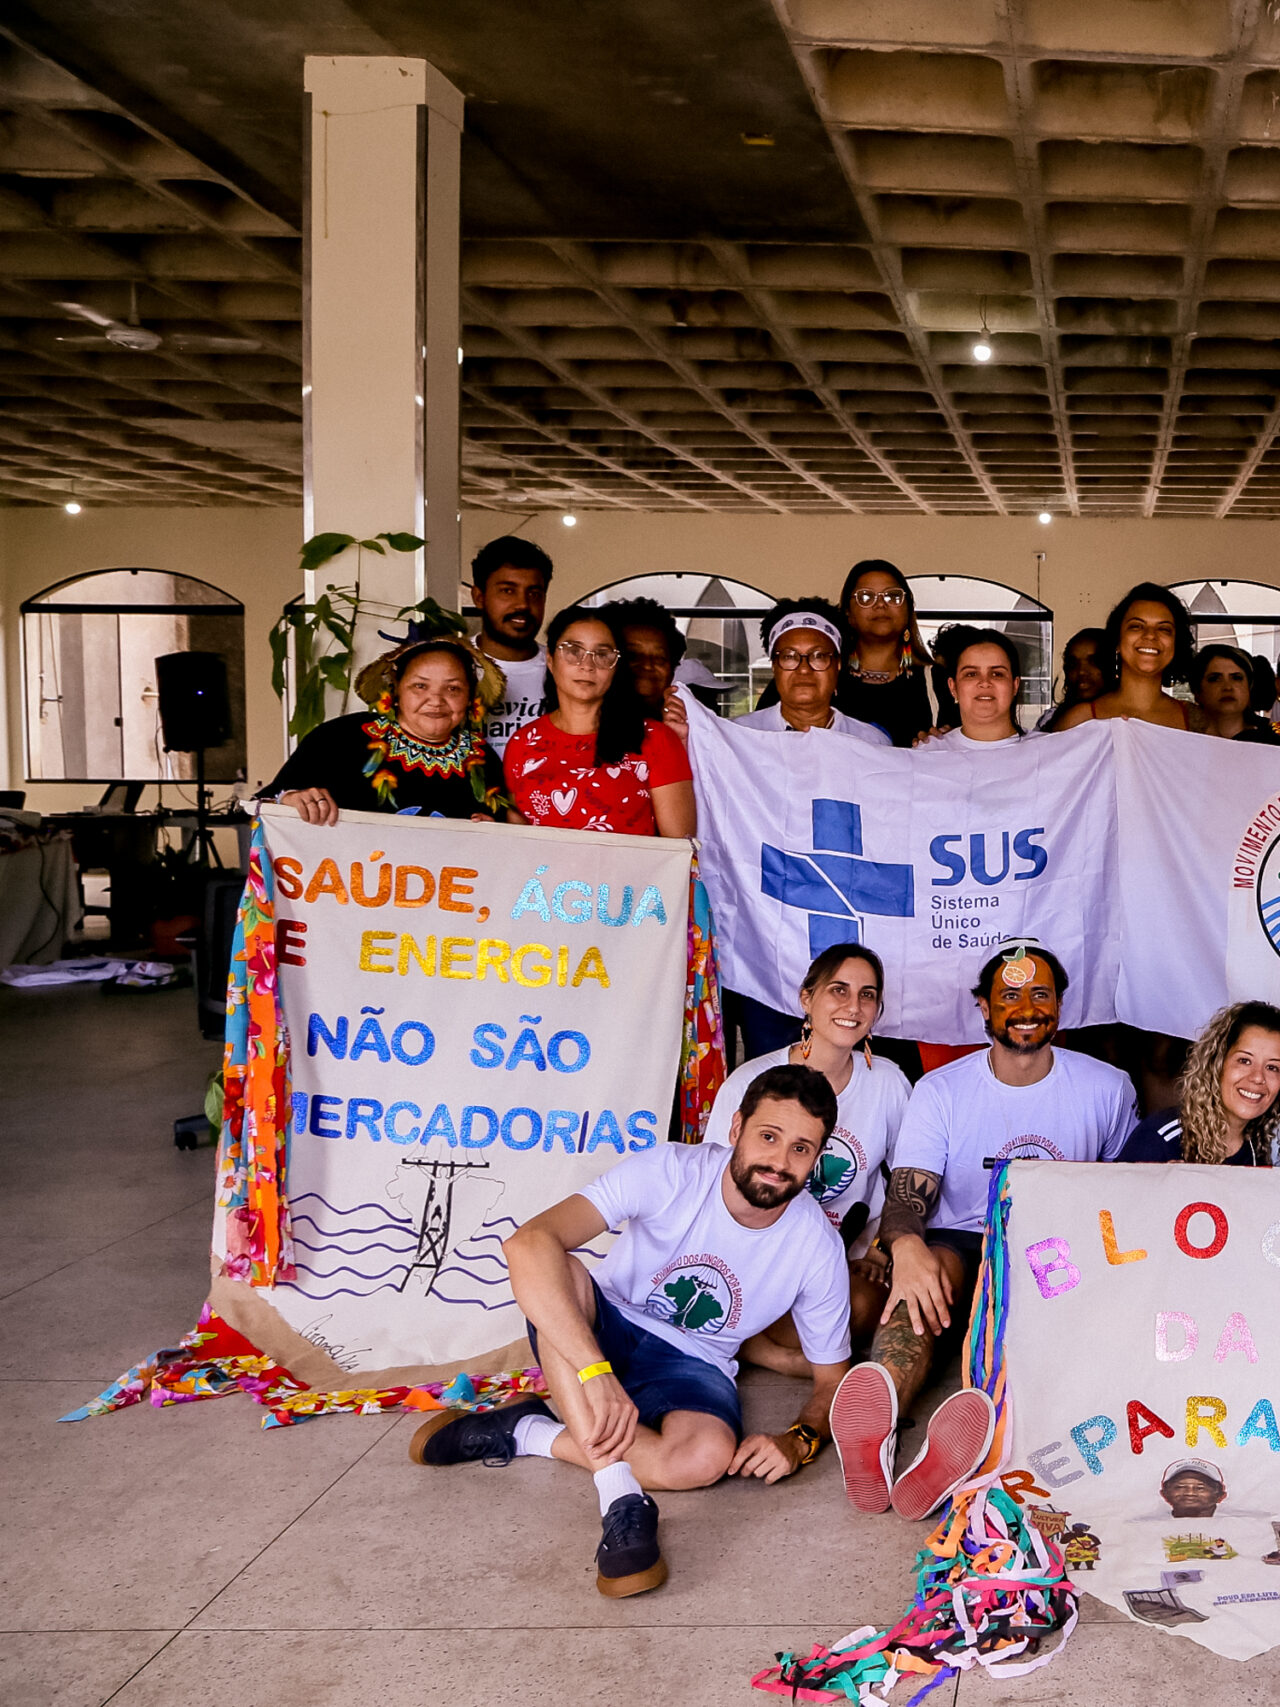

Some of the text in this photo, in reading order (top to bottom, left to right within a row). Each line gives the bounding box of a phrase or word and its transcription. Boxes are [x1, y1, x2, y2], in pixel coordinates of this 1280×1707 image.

[929, 827, 1048, 886] SUS
[273, 850, 667, 927] SAÚDE, ÁGUA
[930, 895, 1000, 910] Sistema
[931, 911, 981, 929] Único
[932, 934, 952, 949] de
[276, 918, 611, 988] E ENERGIA
[307, 1005, 591, 1073] NÃO SÃO
[838, 1127, 851, 1140] POR
[1040, 1137, 1054, 1147] POR
[683, 1254, 699, 1266] DOS
[699, 1253, 731, 1276] ATINGIDOS
[726, 1272, 740, 1290] POR
[726, 1287, 743, 1330] BARRAGENS
[1154, 1310, 1260, 1364] DA
[1033, 1513, 1065, 1523] CULTURA
[1036, 1521, 1061, 1531] VIVA
[1217, 1594, 1239, 1602] POVO
